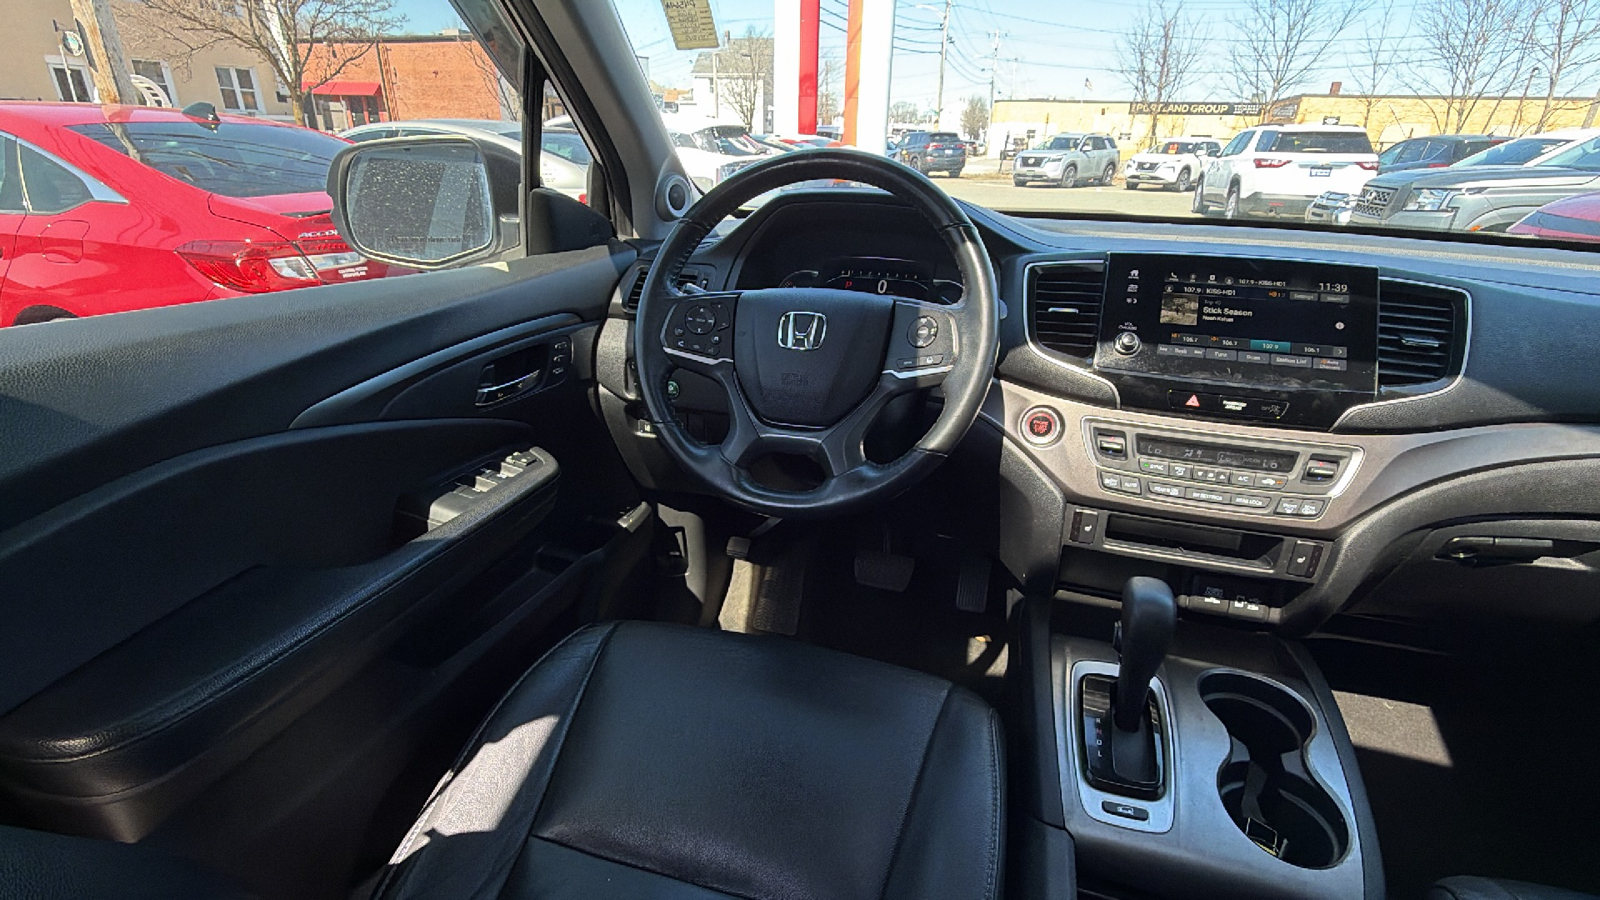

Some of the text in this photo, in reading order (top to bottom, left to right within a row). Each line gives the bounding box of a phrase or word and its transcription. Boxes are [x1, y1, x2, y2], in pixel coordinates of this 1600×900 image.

[1136, 104, 1189, 113] PORTLAND
[1190, 104, 1228, 113] GROUP
[845, 281, 852, 289] P
[877, 279, 887, 294] 0
[1319, 282, 1348, 293] 11:39
[1184, 286, 1236, 296] 107.9 KISS-HD1
[1203, 306, 1253, 316] Stick Season
[1150, 463, 1164, 471] SYNC
